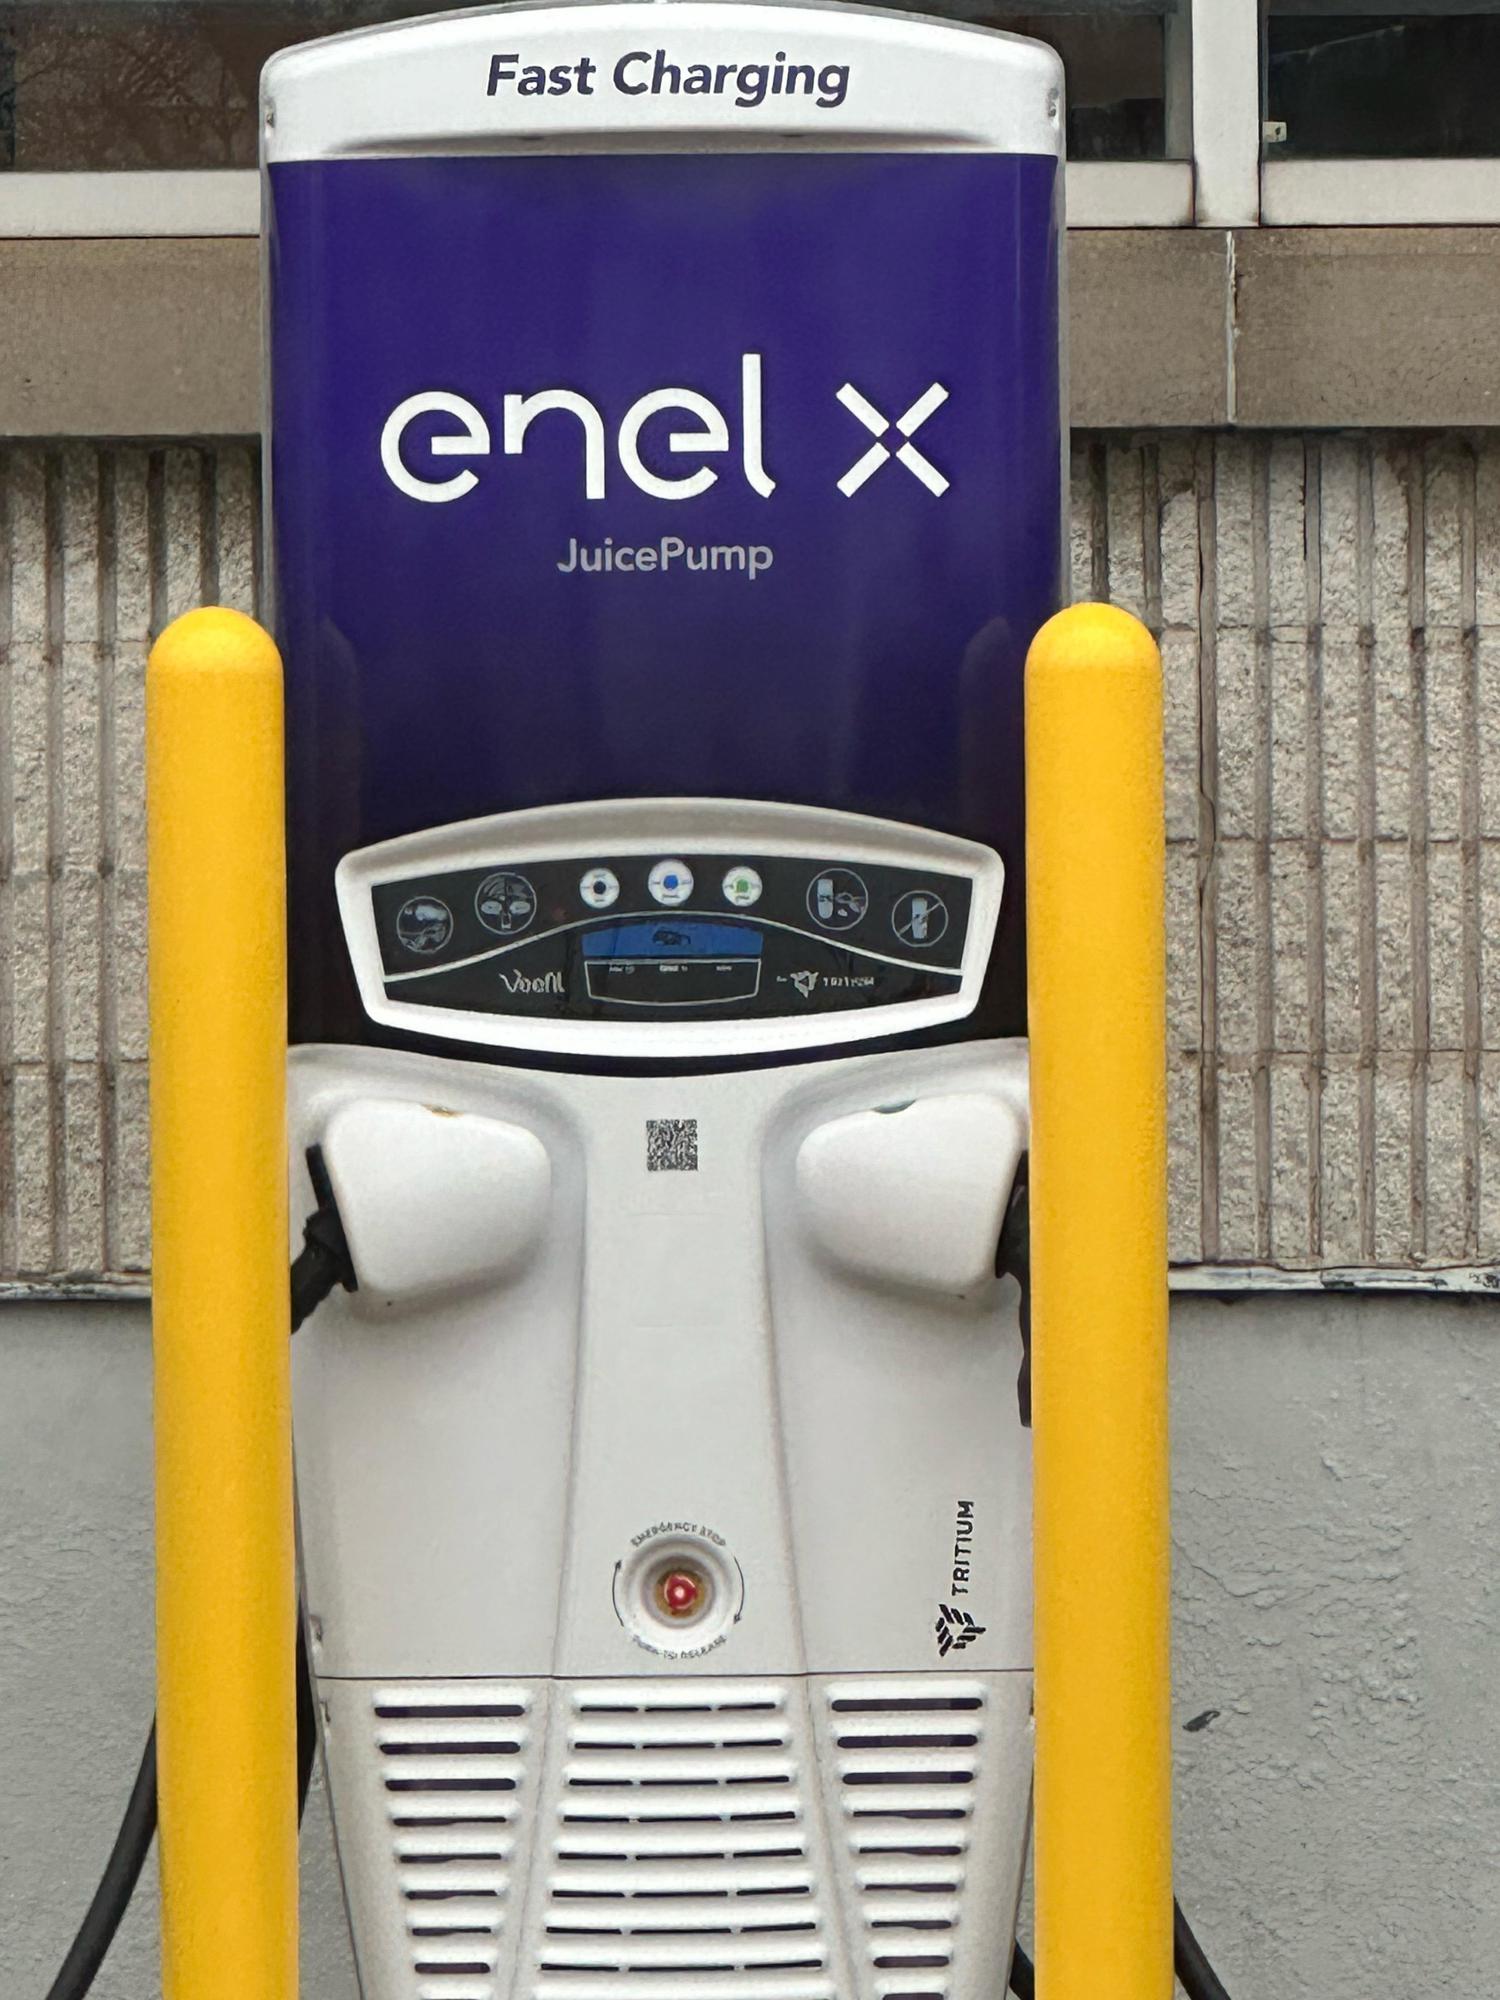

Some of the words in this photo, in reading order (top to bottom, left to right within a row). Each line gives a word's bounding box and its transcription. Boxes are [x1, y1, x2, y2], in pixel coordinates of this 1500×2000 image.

[486, 53, 597, 97] Fast
[613, 49, 850, 108] Charging
[380, 353, 776, 504] enel
[835, 382, 950, 498] x
[556, 536, 774, 581] JuicePump
[951, 1500, 975, 1597] TRITIUM
